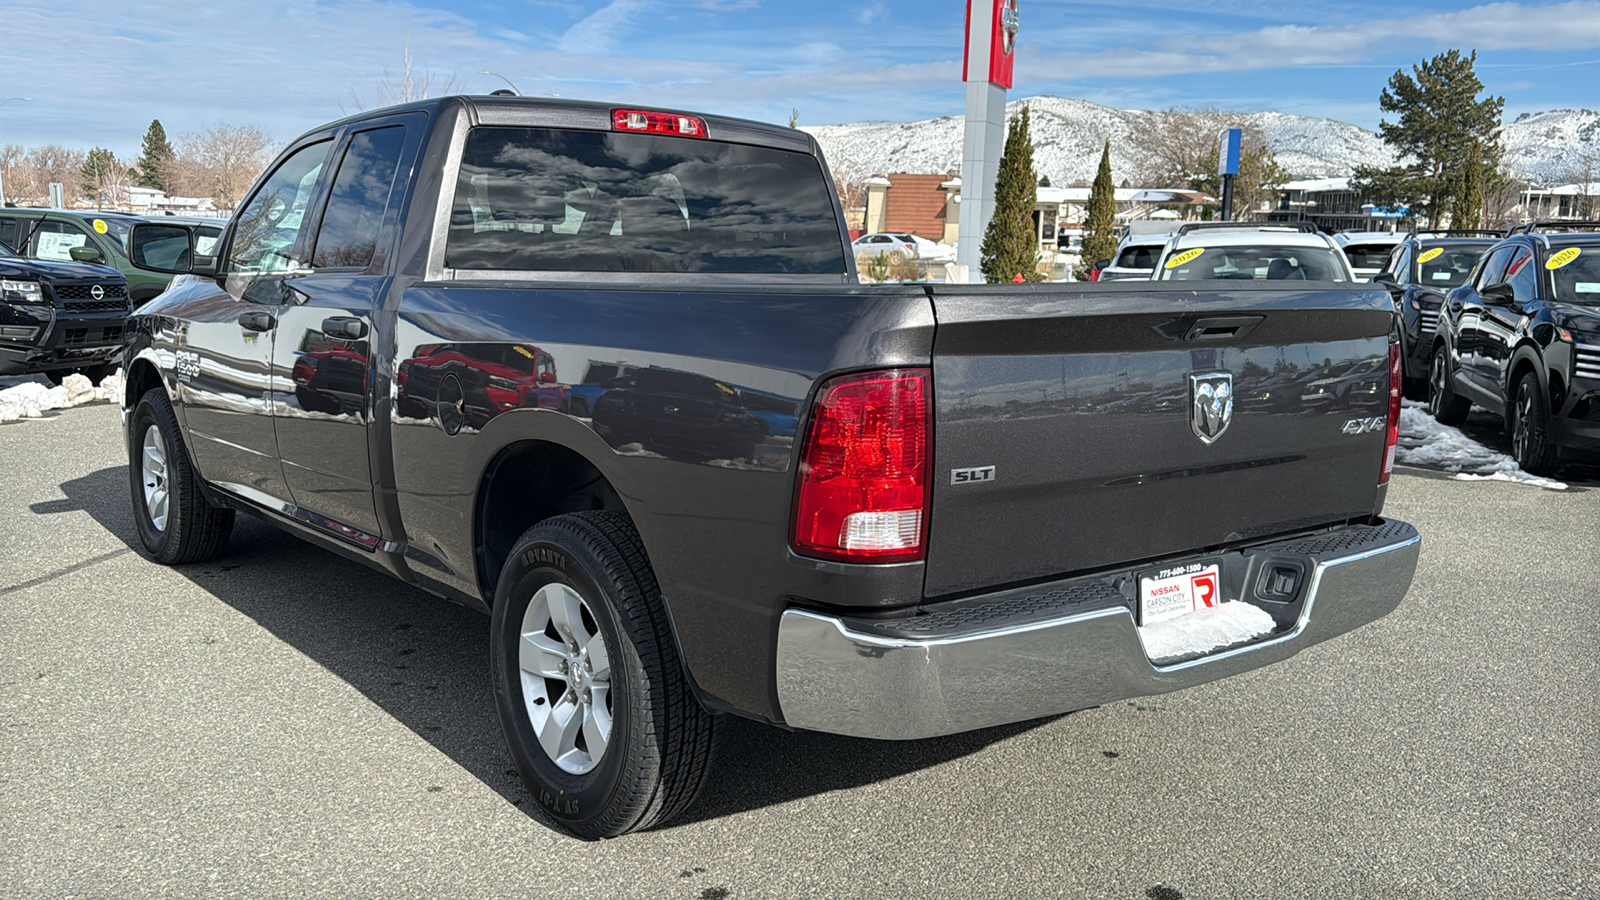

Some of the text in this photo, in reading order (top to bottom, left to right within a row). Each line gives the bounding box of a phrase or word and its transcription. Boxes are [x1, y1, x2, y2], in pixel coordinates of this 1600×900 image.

[1173, 251, 1197, 265] 2026
[1552, 250, 1576, 266] 2026
[955, 469, 993, 482] SLT
[521, 548, 566, 570] ADVANTA
[1159, 563, 1202, 579] 775-600-1500
[1151, 584, 1180, 597] NISSAN
[1146, 593, 1185, 608] CARSON CITY
